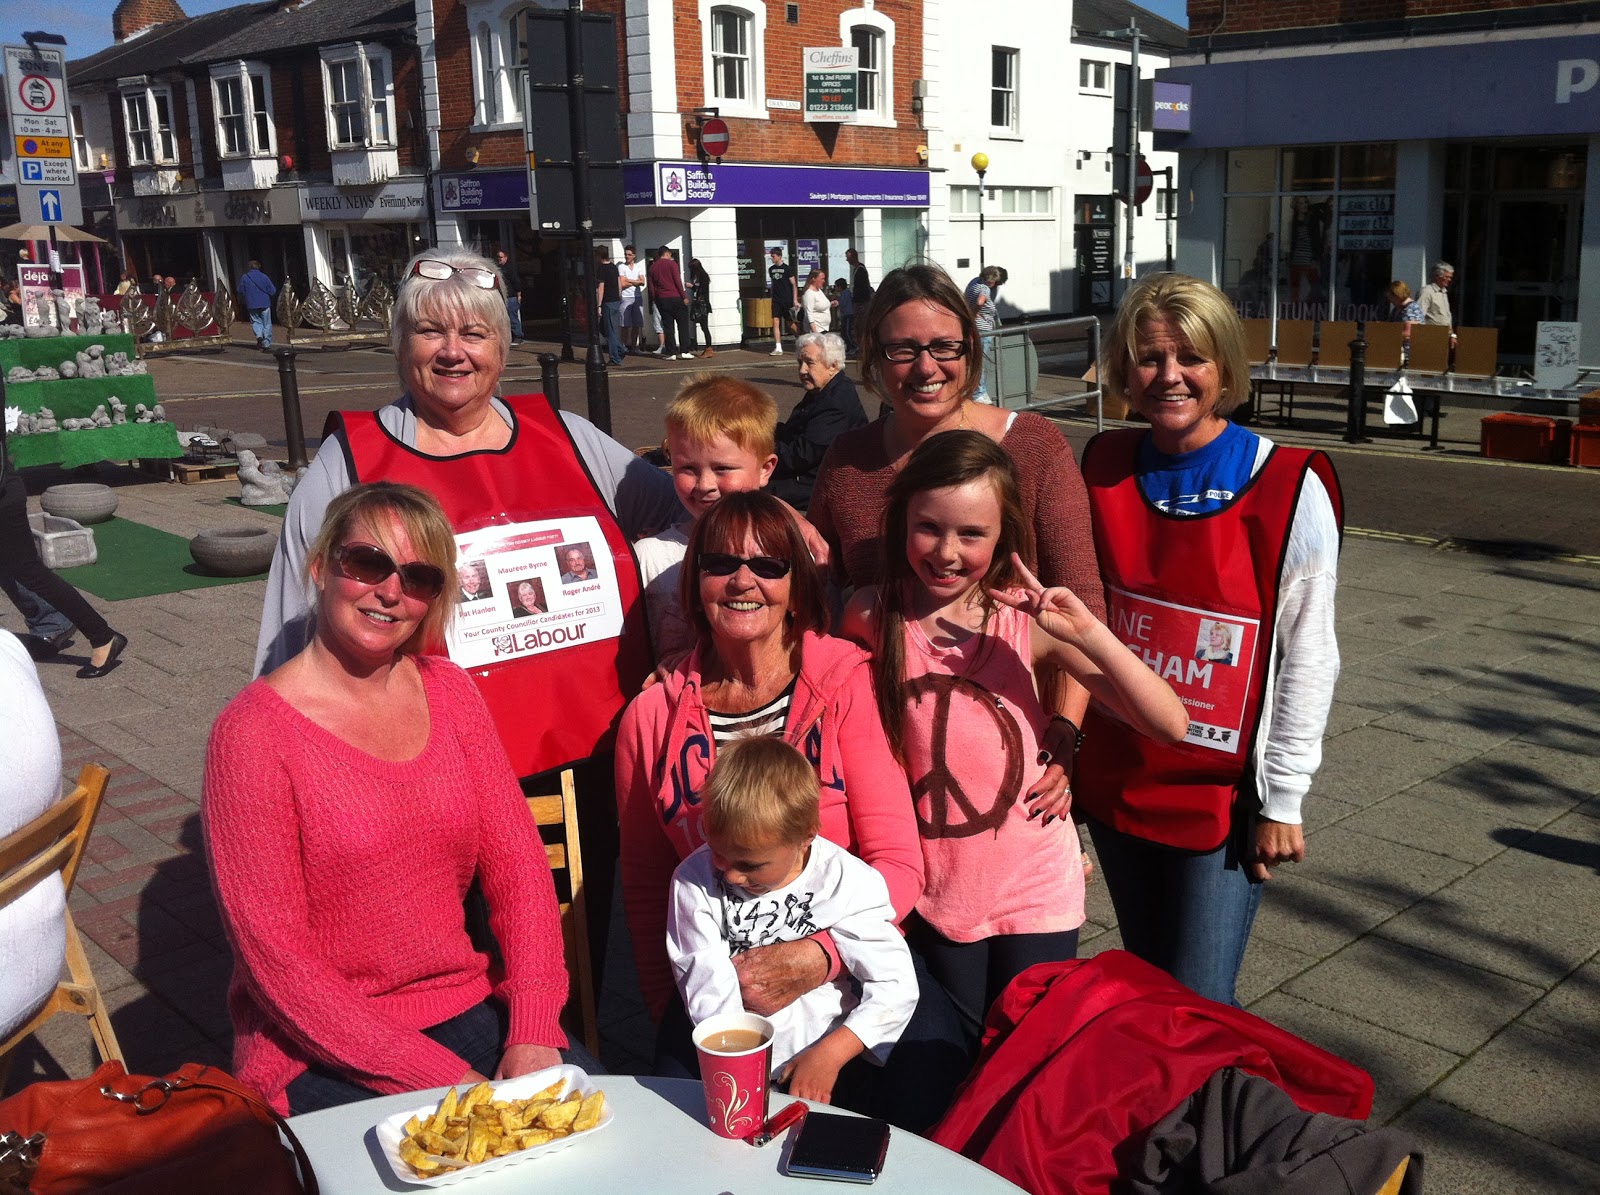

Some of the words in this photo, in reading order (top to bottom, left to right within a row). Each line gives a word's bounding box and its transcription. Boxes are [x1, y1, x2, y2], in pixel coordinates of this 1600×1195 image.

[8, 51, 57, 60] PEDESIAN
[810, 51, 853, 66] Cheffins
[18, 60, 49, 71] ZONE
[1154, 101, 1189, 113] peacocks
[687, 170, 713, 180] Saffron
[460, 179, 480, 188] Saffron
[688, 180, 716, 191] Building
[461, 188, 483, 198] Building
[688, 190, 715, 200] Society
[809, 193, 827, 201] Savings
[305, 196, 342, 210] WEEKLY
[346, 195, 374, 209] NEWS
[380, 197, 406, 210] Evening
[406, 196, 425, 207] News
[461, 196, 482, 206] Society
[1234, 301, 1252, 319] HE
[1338, 304, 1379, 321] LOOK
[1209, 491, 1230, 499] POLICE
[497, 564, 528, 575] Maureen
[528, 560, 548, 571] Byrne
[562, 588, 582, 597] Roger
[582, 583, 601, 594] André
[471, 606, 496, 616] Hanlon
[463, 630, 480, 639] Your
[481, 626, 505, 636] County
[506, 618, 539, 631] Councillor
[540, 611, 574, 624] Candidates
[575, 609, 584, 617] for
[585, 606, 601, 615] 2013
[1109, 604, 1153, 641] ANE
[512, 622, 587, 653] Labour
[1127, 644, 1213, 689] HAM
[1178, 696, 1215, 711] issioner
